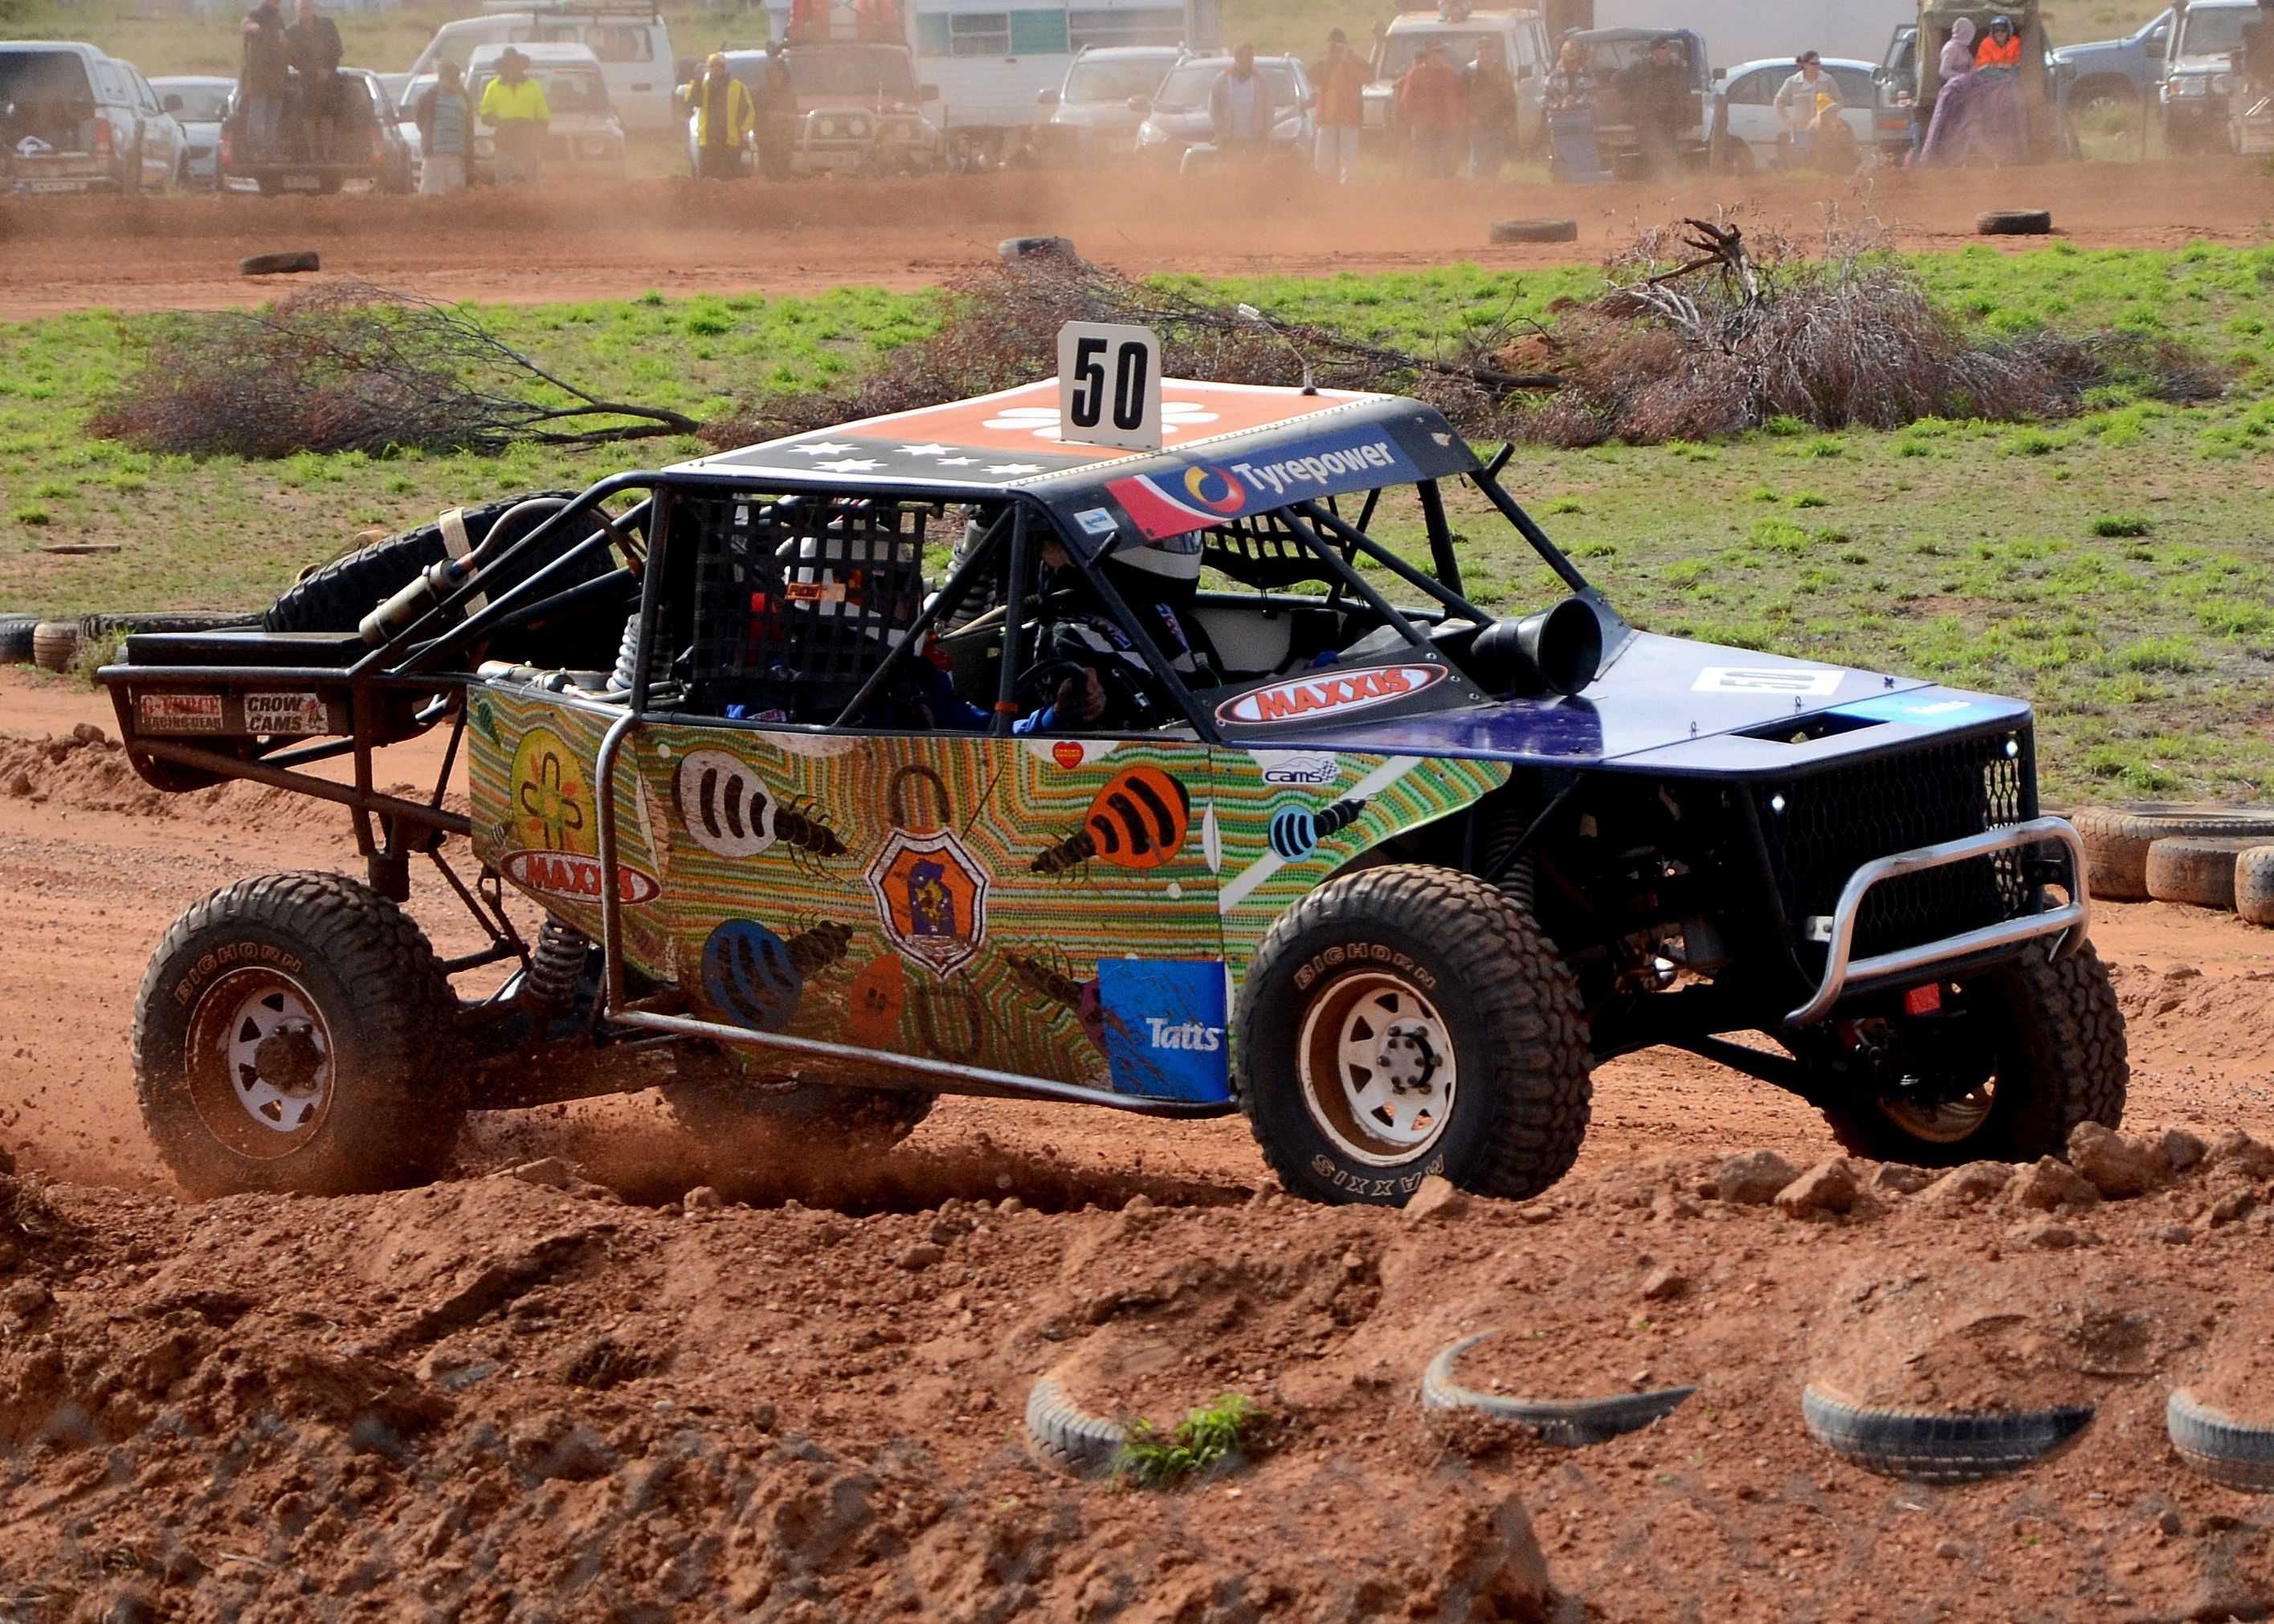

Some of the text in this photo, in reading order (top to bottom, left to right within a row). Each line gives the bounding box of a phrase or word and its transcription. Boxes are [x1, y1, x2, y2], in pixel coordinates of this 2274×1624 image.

[1071, 337, 1148, 430] 50
[1231, 442, 1395, 495] Tyrepower
[248, 697, 301, 711] CROW
[1255, 668, 1411, 720] MAXXIS
[250, 716, 302, 731] CAMS
[526, 855, 635, 900] MAXXS
[174, 942, 303, 1004] BIGHORN
[1294, 943, 1436, 989] BIGHORN
[1145, 1018, 1224, 1051] Tatts
